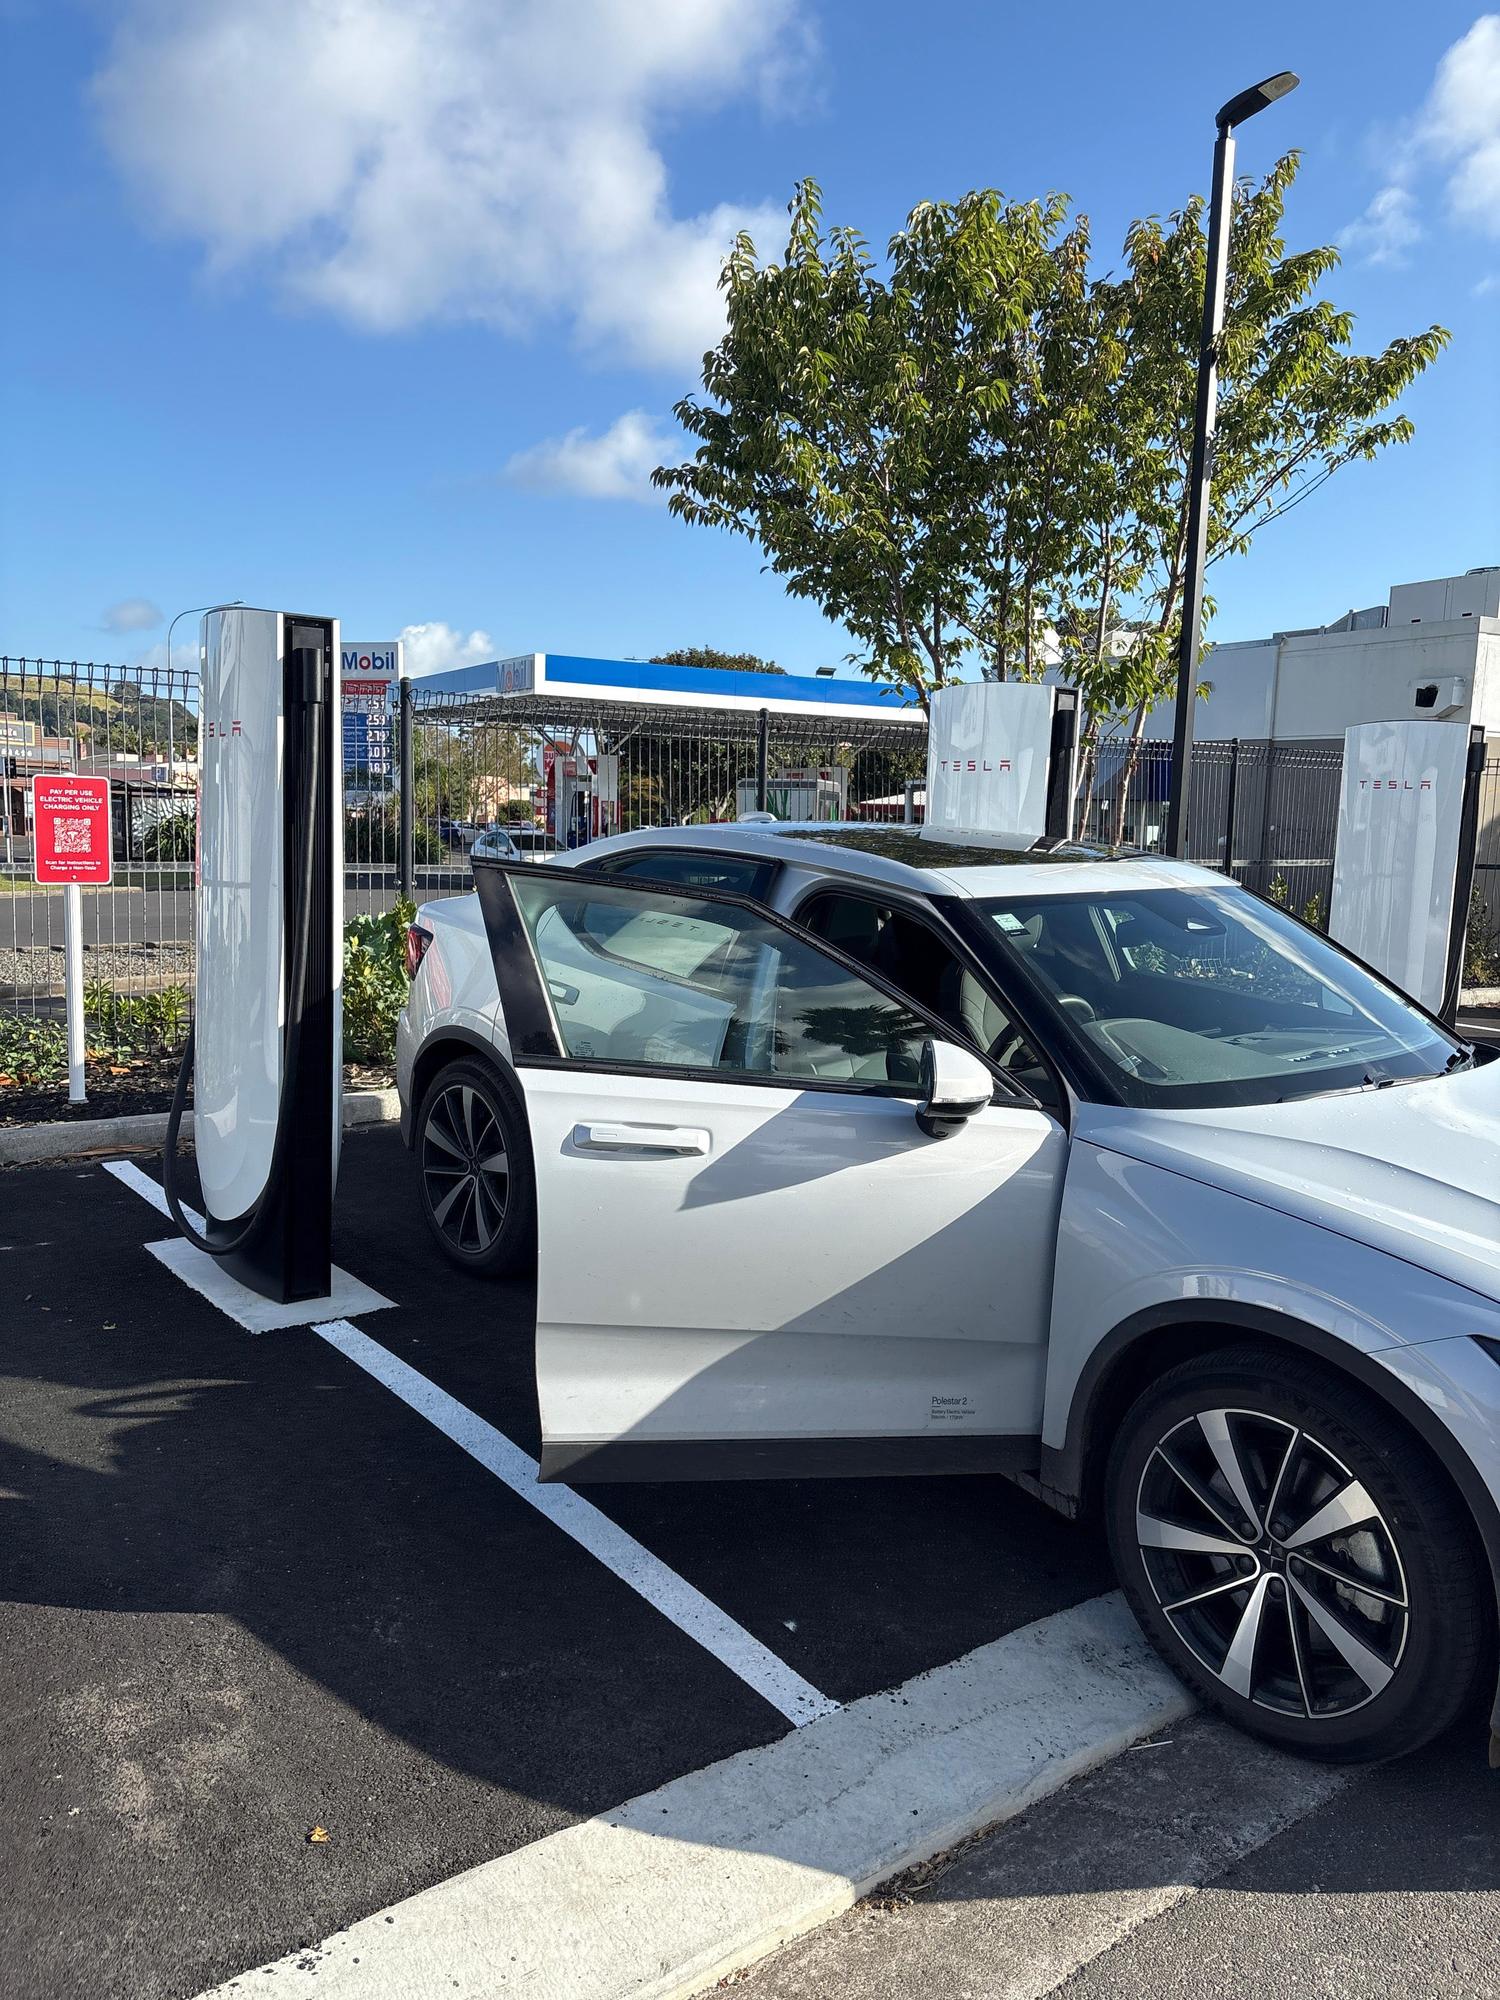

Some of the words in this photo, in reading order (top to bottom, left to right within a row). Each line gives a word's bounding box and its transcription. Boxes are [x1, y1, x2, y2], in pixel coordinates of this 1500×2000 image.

[341, 651, 395, 670] Mobil
[496, 660, 527, 692] Mobil
[941, 760, 1011, 772] TESLA
[1359, 780, 1431, 790] TESLA
[931, 1396, 962, 1405] Polestar
[962, 1396, 968, 1406] 2
